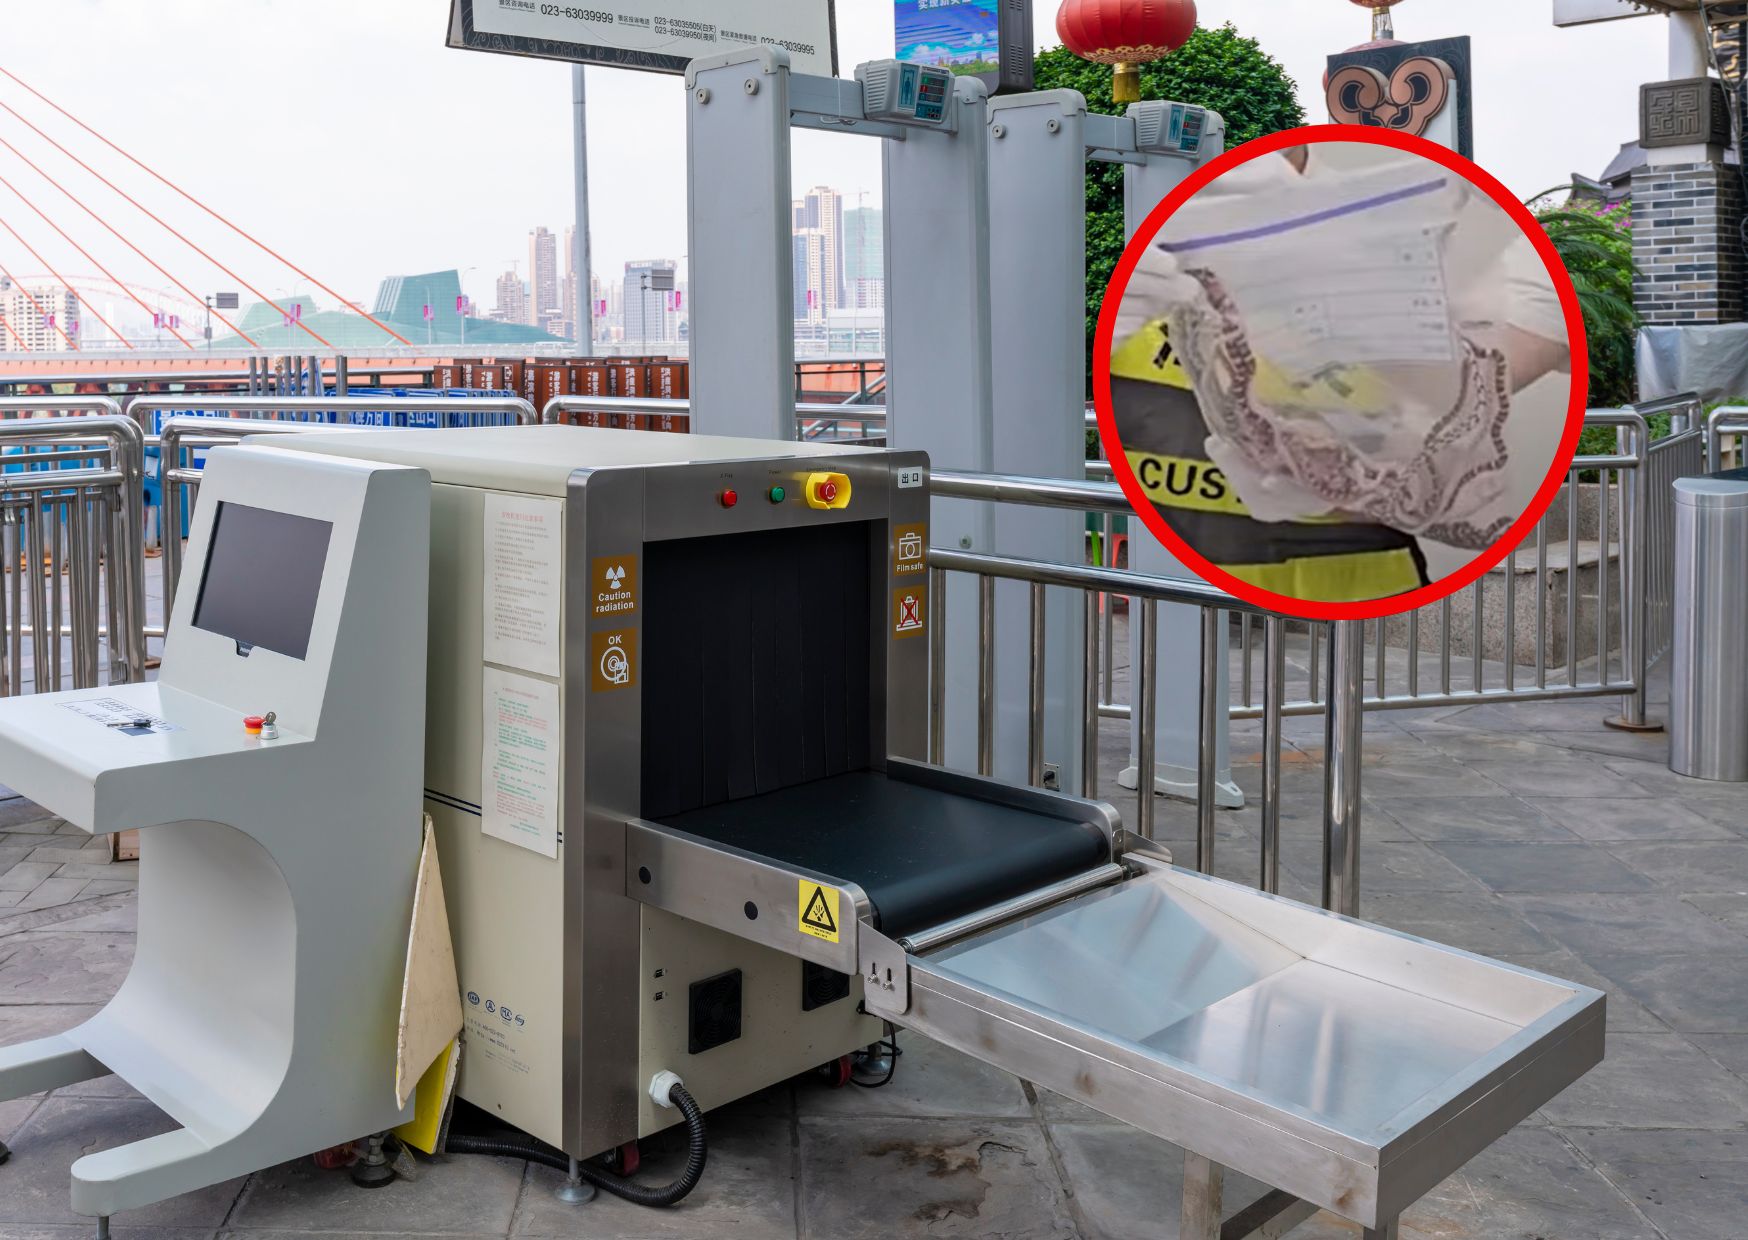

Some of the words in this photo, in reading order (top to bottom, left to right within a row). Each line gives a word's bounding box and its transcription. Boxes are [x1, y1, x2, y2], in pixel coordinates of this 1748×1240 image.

[541, 3, 614, 24] 023-63039999
[901, 472, 919, 484] 出口
[1139, 457, 1242, 504] CUS
[896, 563, 910, 572] Film
[910, 562, 924, 571] safe
[598, 590, 631, 602] Caution
[595, 601, 634, 613] radiation
[608, 634, 622, 645] OK
